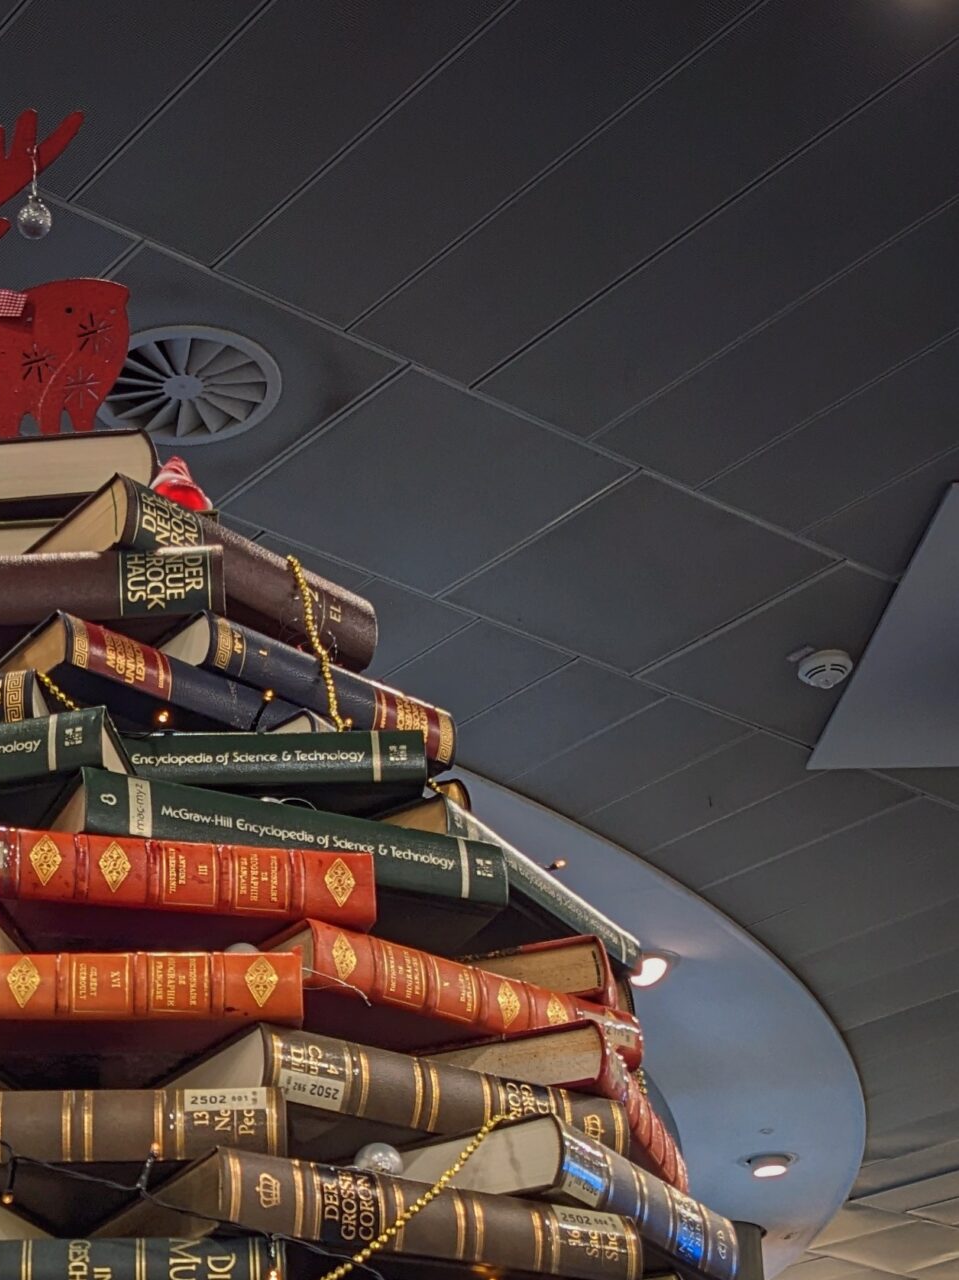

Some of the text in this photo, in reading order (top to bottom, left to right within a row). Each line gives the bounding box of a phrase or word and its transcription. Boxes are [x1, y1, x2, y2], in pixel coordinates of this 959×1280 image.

[141, 493, 158, 533] DER
[127, 554, 146, 603] HAUS
[184, 553, 203, 592] DER
[131, 750, 365, 766] Encyclopedia of Science & Technology
[101, 793, 117, 806] 8
[161, 806, 233, 829] McGraw-Hill
[236, 818, 315, 847] Encyclopedia
[317, 832, 331, 848] of
[332, 836, 375, 854] Science
[378, 844, 388, 855] &
[390, 844, 456, 870] Technology
[198, 865, 208, 875] III
[110, 971, 120, 988] XVI
[191, 1095, 227, 1105] 2502
[310, 1083, 340, 1100] 2502
[194, 1111, 209, 1126] 13
[322, 1181, 338, 1222] DER
[340, 1171, 357, 1241] GROSSE
[356, 1174, 375, 1241] CORON
[560, 1213, 592, 1226] 2502
